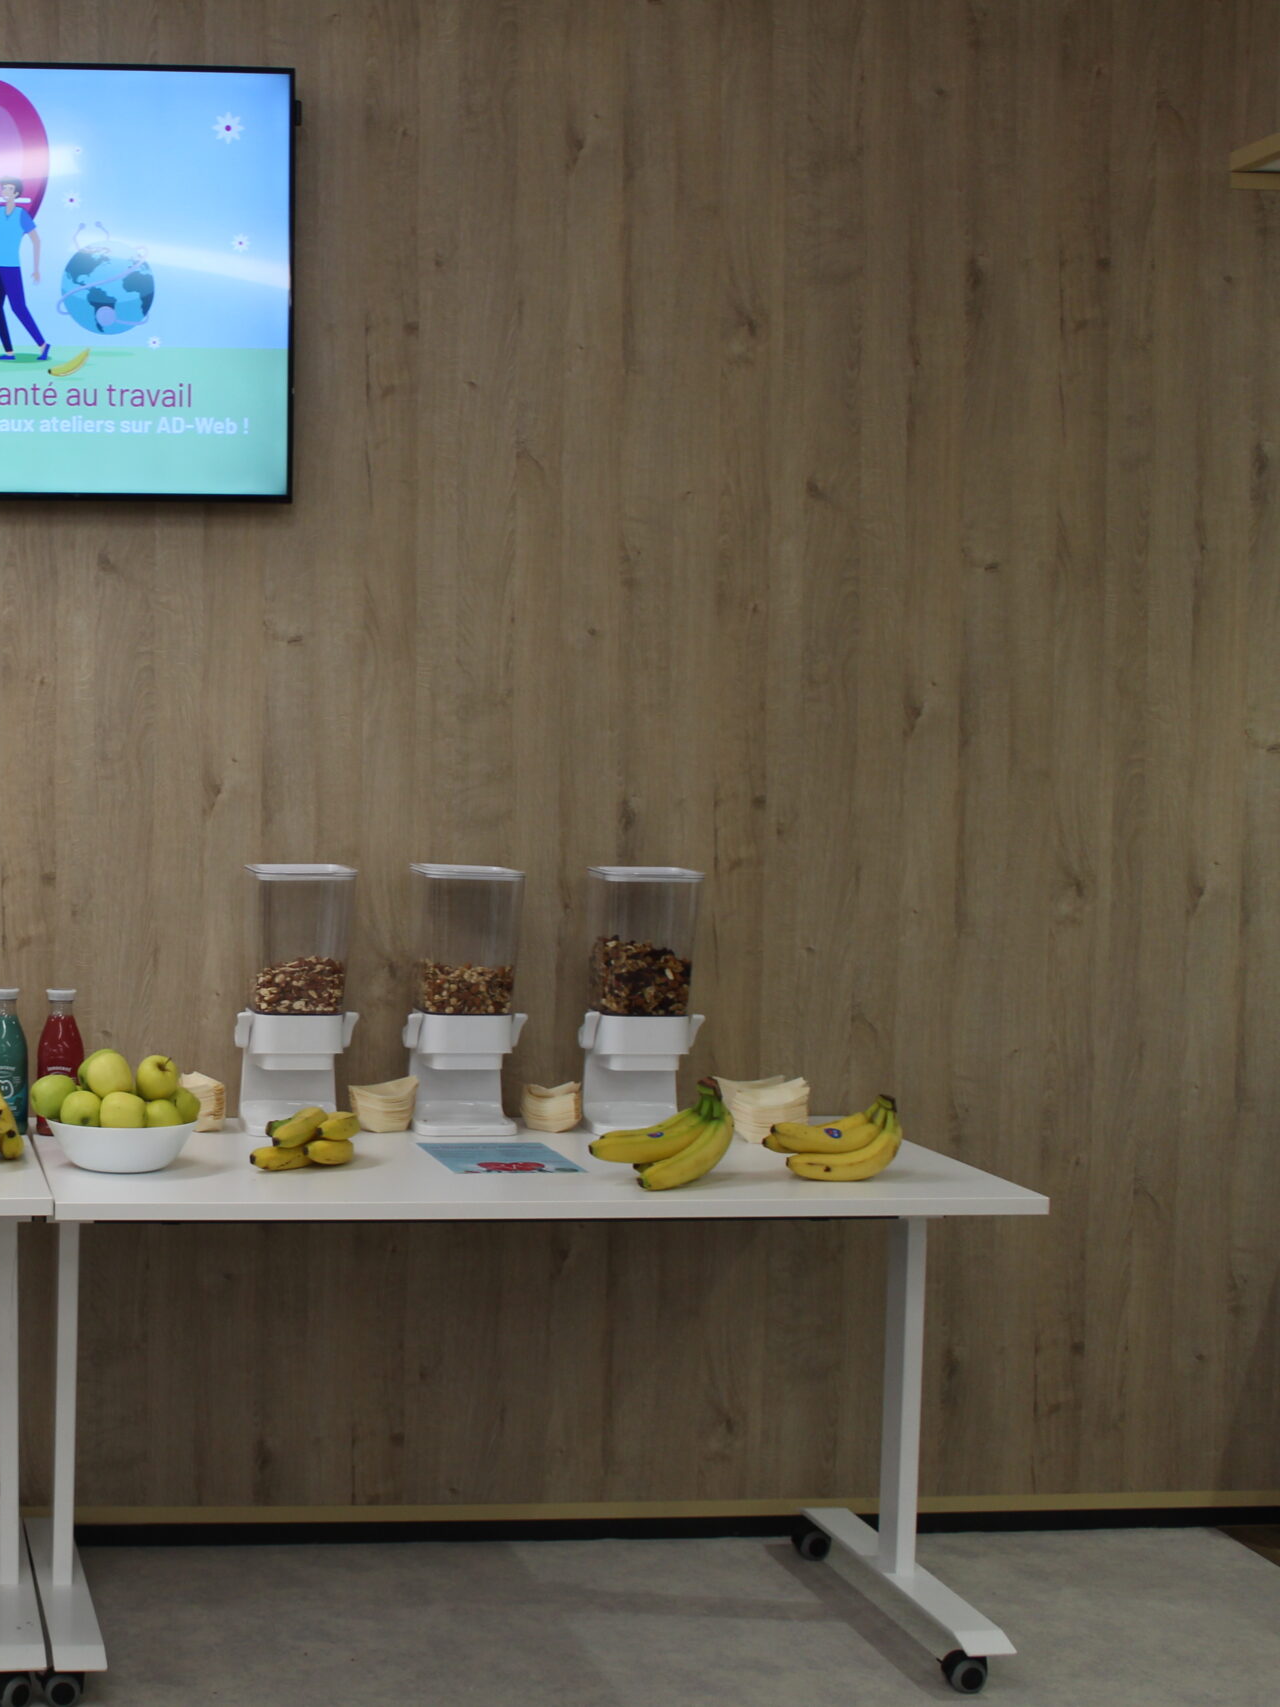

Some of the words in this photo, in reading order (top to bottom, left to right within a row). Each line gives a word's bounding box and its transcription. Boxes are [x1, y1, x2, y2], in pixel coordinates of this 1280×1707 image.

[66, 388, 98, 407] au
[106, 383, 192, 408] travail
[39, 415, 115, 434] ateliers
[120, 419, 152, 434] sur
[156, 416, 238, 435] AD-Web
